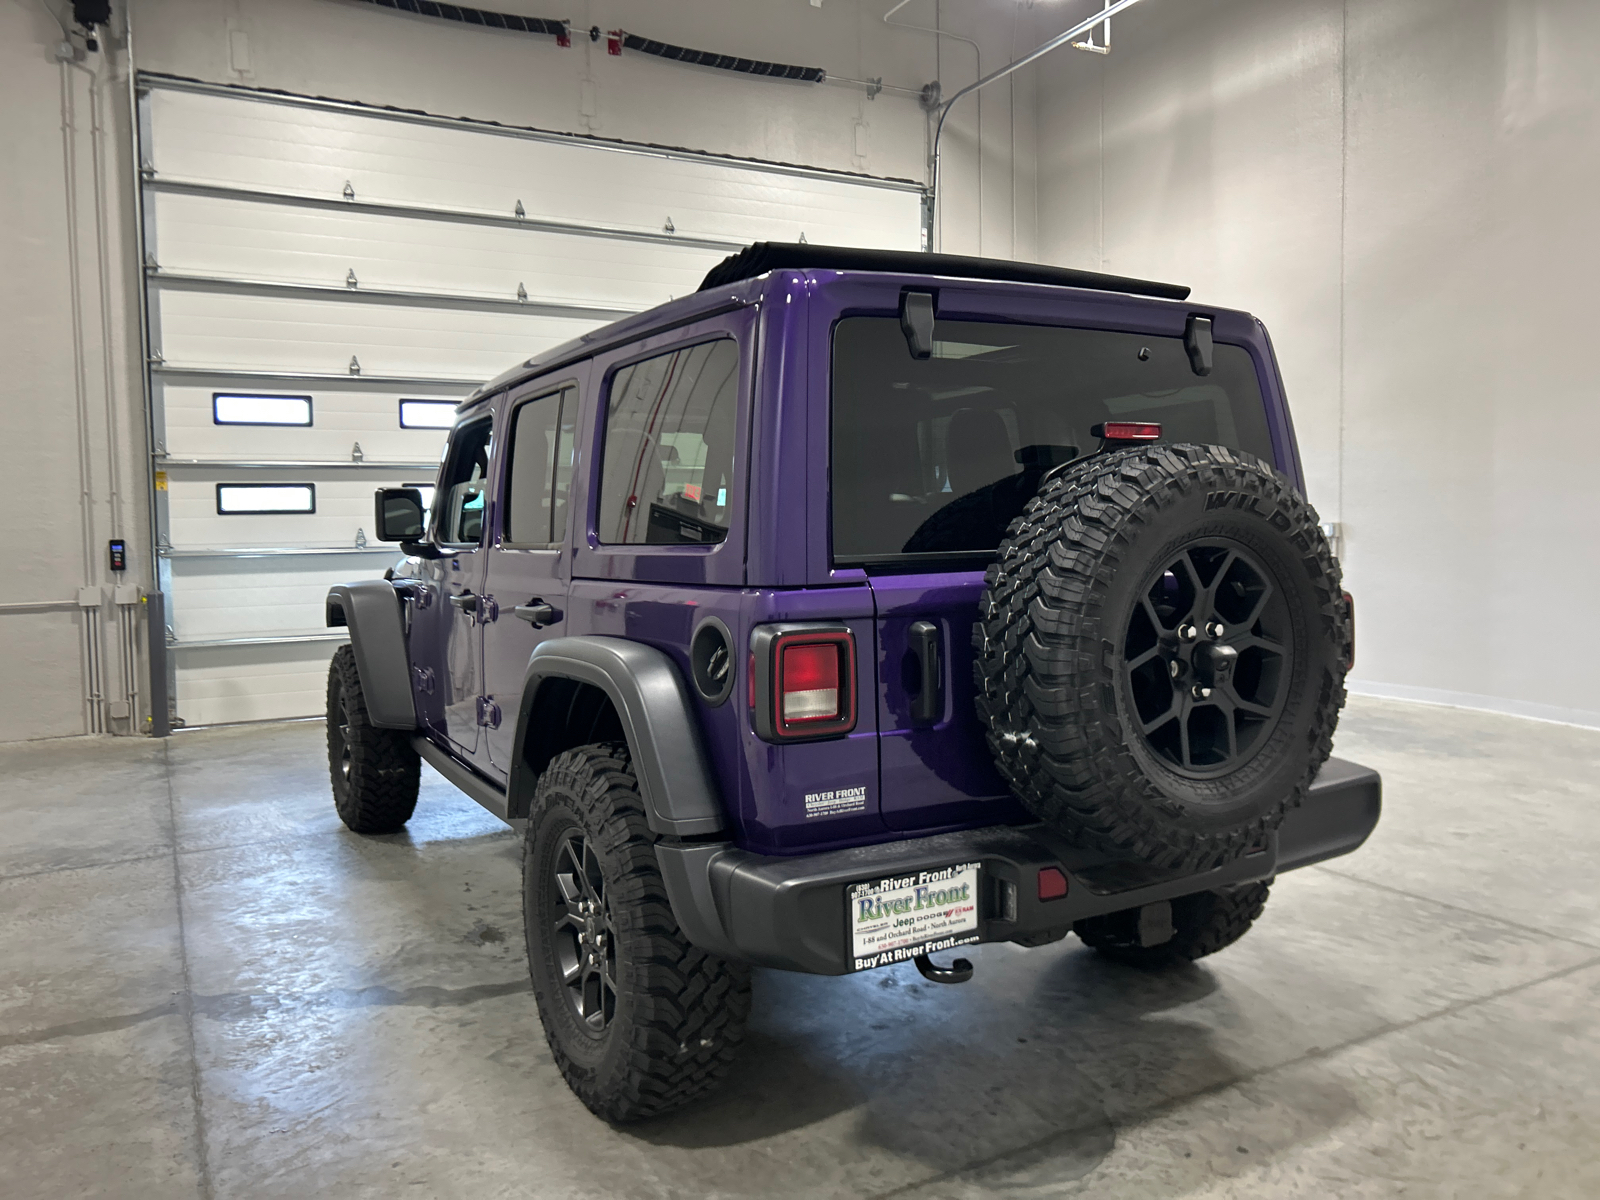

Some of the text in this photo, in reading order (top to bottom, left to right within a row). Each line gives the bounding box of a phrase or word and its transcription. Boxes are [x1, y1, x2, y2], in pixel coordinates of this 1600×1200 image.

[805, 791, 834, 803] RIVER
[836, 786, 866, 799] FRONT
[880, 867, 952, 892] River Front
[863, 917, 966, 946] I-88 and Orchard Road North Aurora
[893, 916, 915, 928] Jeep
[916, 910, 948, 921] DODGE
[855, 935, 980, 970] Buy At River Front.com
